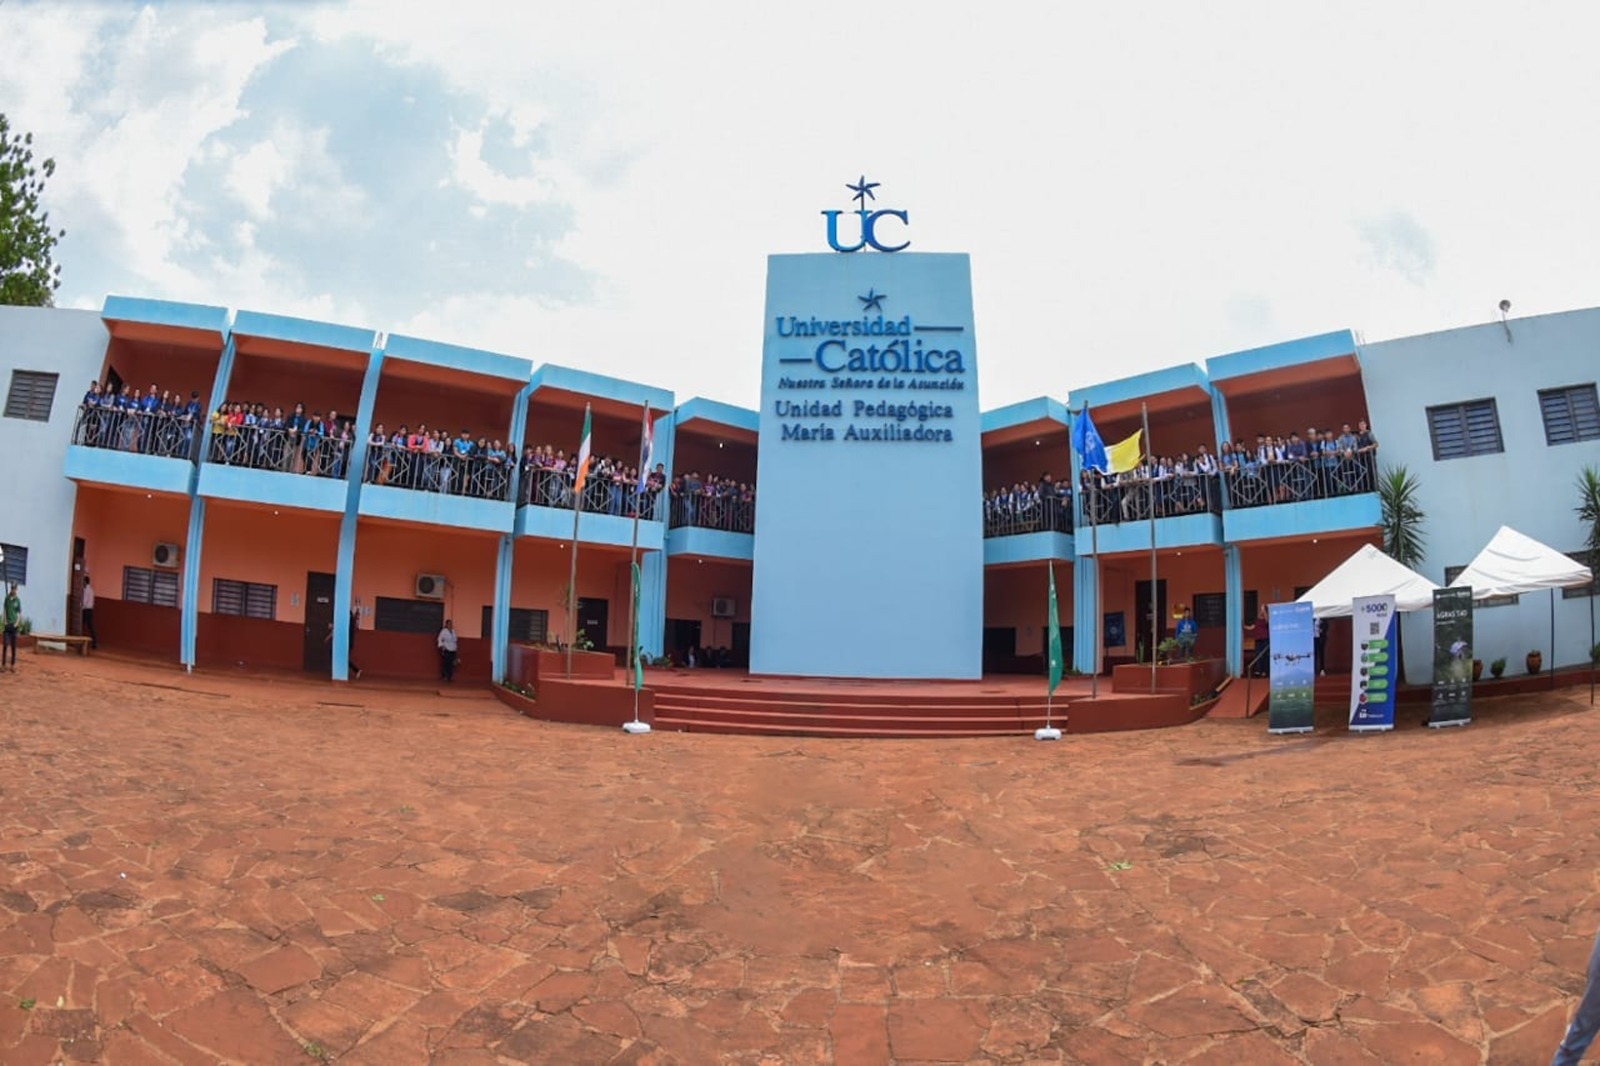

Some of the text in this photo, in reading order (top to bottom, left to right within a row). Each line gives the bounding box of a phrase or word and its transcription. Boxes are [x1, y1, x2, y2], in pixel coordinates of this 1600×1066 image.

[821, 209, 911, 253] UC
[775, 315, 912, 337] Universidad
[815, 339, 965, 374] Católica
[778, 377, 964, 391] Nuestra Señora de la Asunción
[775, 400, 954, 422] Unidad Pedagógica
[781, 423, 954, 443] María Auxiliadora
